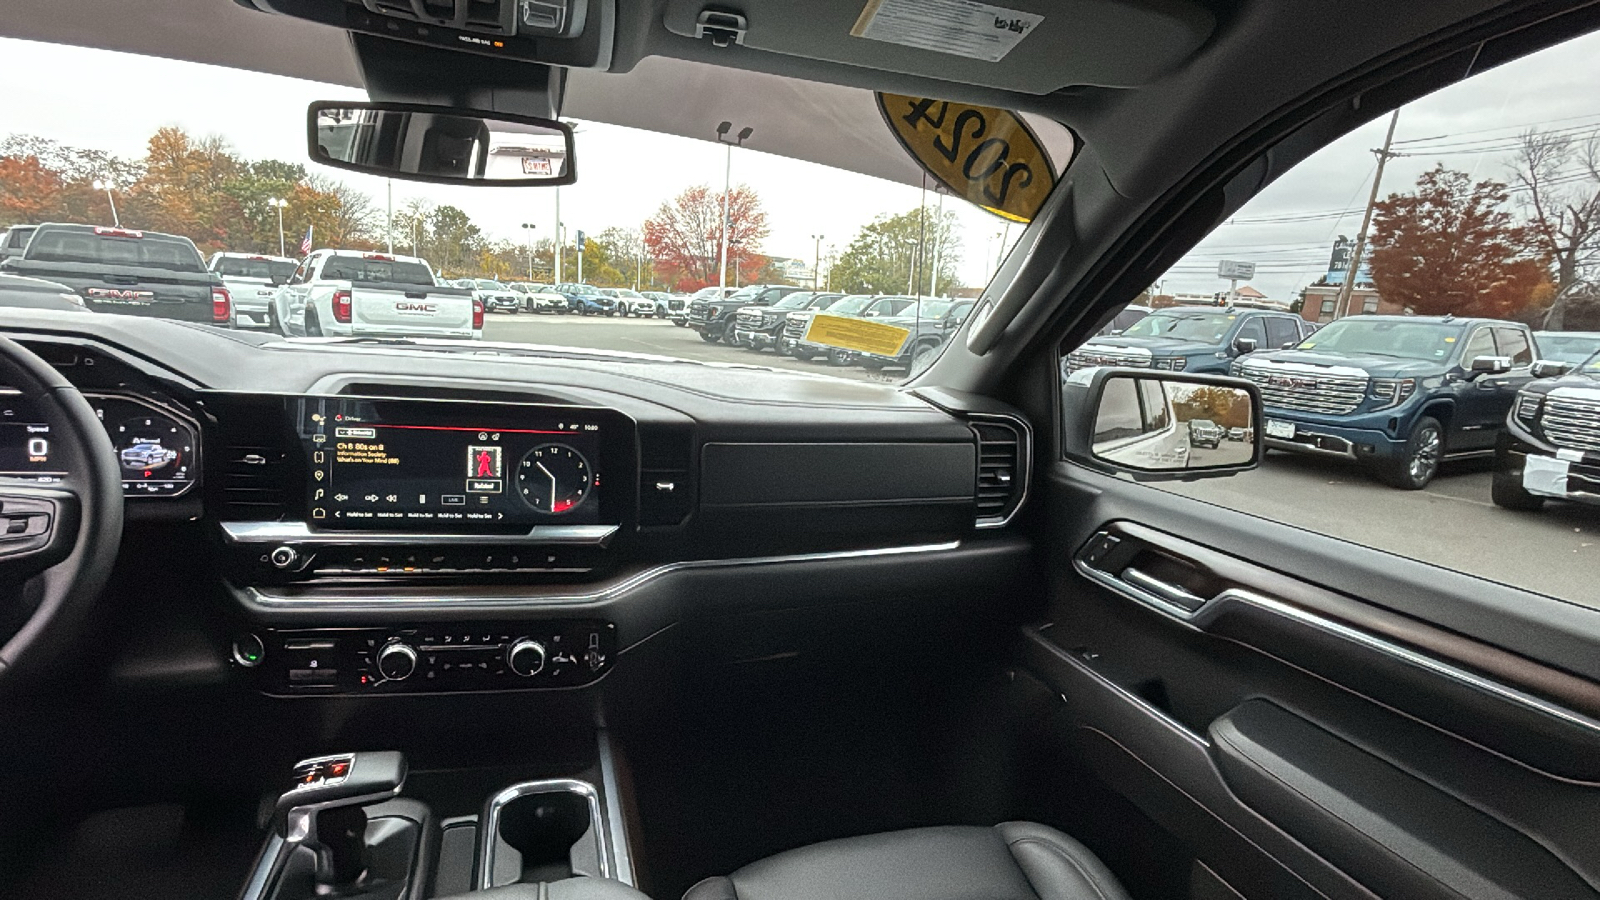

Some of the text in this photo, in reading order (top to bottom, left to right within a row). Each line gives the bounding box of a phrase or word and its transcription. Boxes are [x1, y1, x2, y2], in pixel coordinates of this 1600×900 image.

[88, 288, 154, 300] GMC
[396, 302, 436, 312] GMC
[337, 442, 347, 450] Ch
